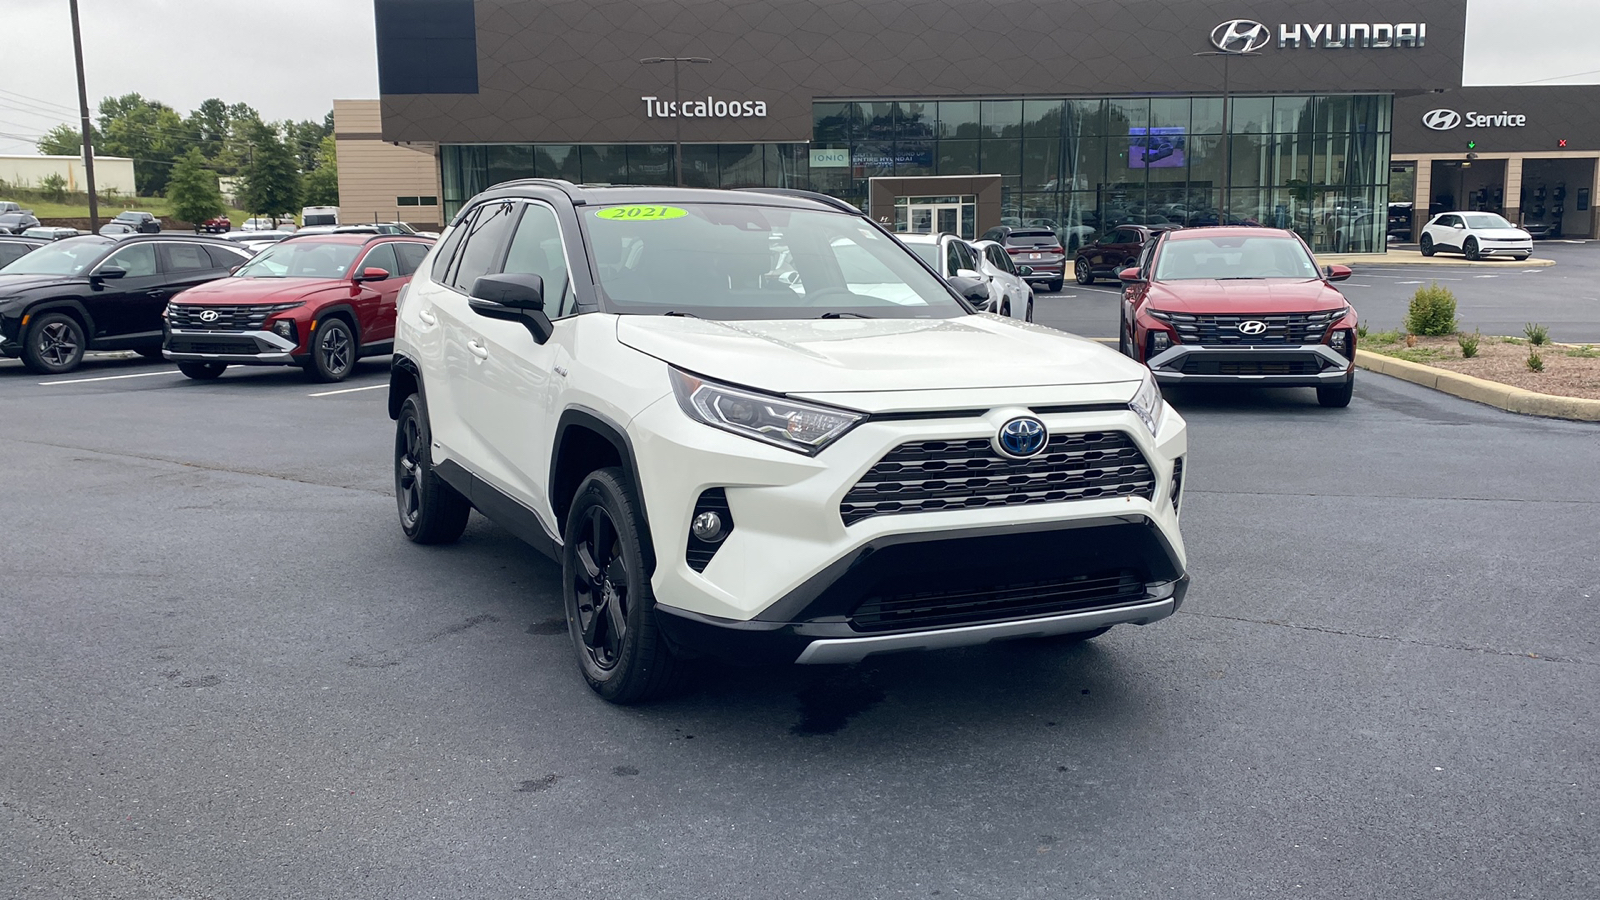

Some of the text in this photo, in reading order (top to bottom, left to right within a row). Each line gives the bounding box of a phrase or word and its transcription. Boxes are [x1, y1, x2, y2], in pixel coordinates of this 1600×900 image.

[1278, 23, 1426, 48] HYUNDAI
[641, 96, 767, 118] Tuscaloosa
[1465, 111, 1526, 128] Service
[813, 154, 844, 162] IONIQ
[612, 207, 668, 219] 2021
